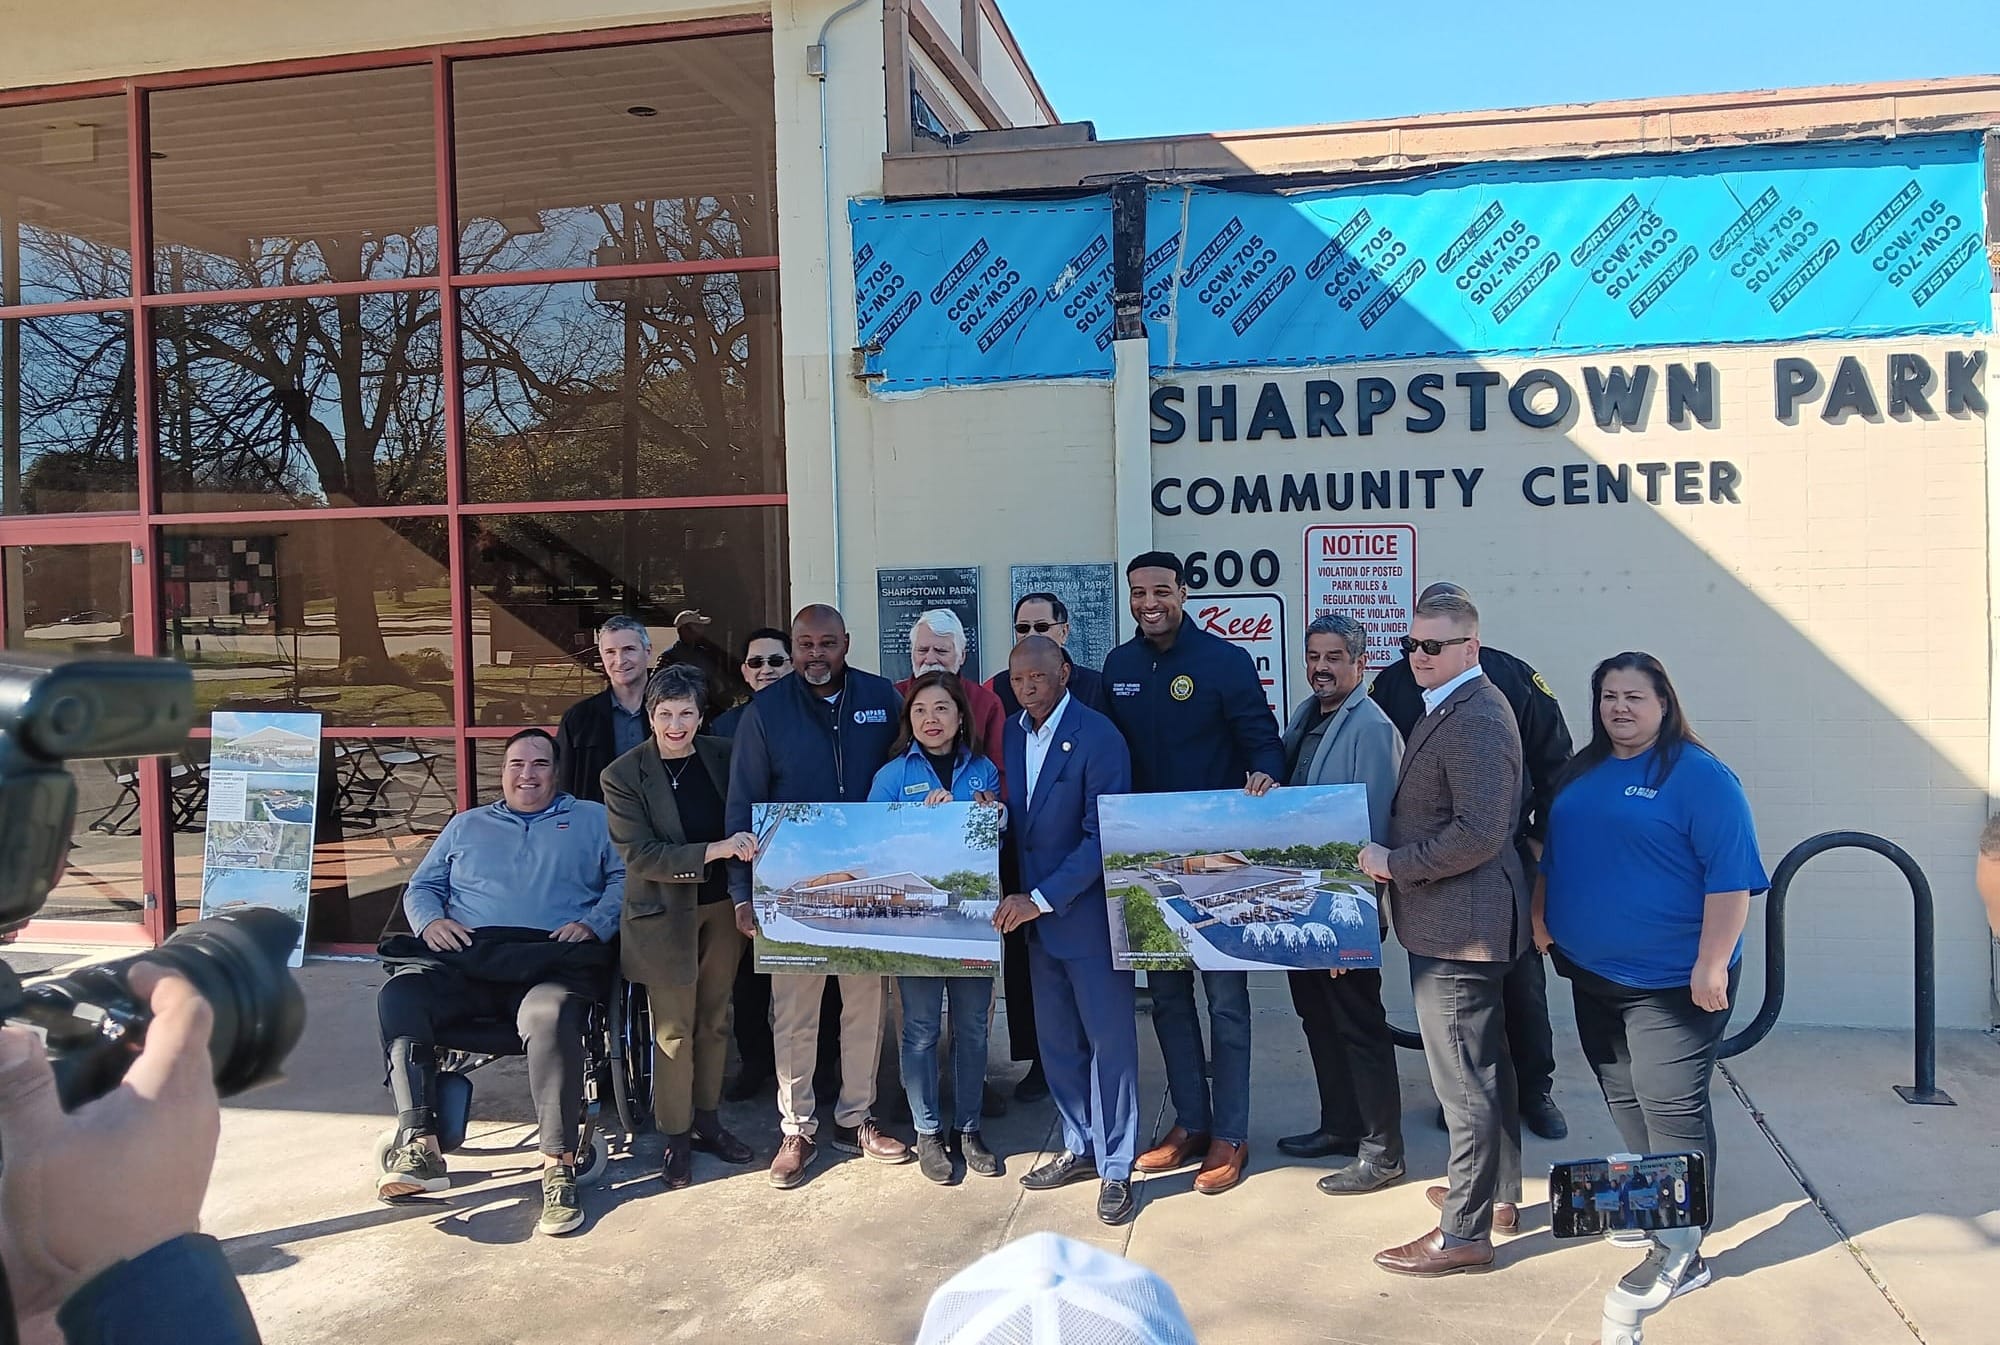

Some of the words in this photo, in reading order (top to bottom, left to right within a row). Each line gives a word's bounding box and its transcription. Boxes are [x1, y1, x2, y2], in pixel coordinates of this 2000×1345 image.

[1305, 208, 1372, 280] CARLISLE
[1436, 200, 1504, 273] CARLISLE
[1571, 194, 1640, 267] CARLISLE
[1592, 214, 1663, 284] CCW-705
[1709, 186, 1780, 260] CARLISLE
[1731, 207, 1803, 278] CCW-705
[1851, 179, 1922, 254] CARLISLE
[1873, 200, 1945, 272] CCW-705
[931, 238, 989, 305] CARLISLE
[1180, 216, 1244, 288] CARLISLE
[1199, 235, 1264, 304] CCW-705
[1325, 227, 1392, 297] CCW-705
[1456, 220, 1525, 290] CCW-705
[1628, 246, 1699, 319] CARLISLE
[1769, 239, 1840, 313] CARLISLE
[1913, 233, 1983, 308] CARLISLE
[948, 257, 1008, 321] CCW-705
[977, 287, 1037, 353] CARLISLE
[1232, 266, 1296, 336] CARLISLE
[1360, 259, 1426, 331] CARLISLE
[1492, 252, 1560, 324] CARLISLE
[1150, 362, 1714, 443] SHARPSTOWN
[1775, 351, 1987, 420] PARK
[1152, 468, 1484, 515] COMMUNITY
[1522, 460, 1739, 507] CENTER
[1318, 567, 1358, 577] VIOLATION
[1360, 567, 1370, 576] OF
[1373, 566, 1402, 576] POSTED
[1322, 535, 1398, 555] NOTICE
[881, 587, 945, 597] SHARPSTOWN
[949, 586, 972, 595] PARK
[1323, 594, 1376, 605] REGULATIONS
[1378, 594, 1397, 605] WILL
[1332, 581, 1352, 591] PARK
[1355, 581, 1379, 591] RULES
[1382, 581, 1388, 590] &
[1351, 608, 1365, 618] THE
[1367, 608, 1406, 618] VIOLATOR
[1199, 606, 1273, 642] Keep
[1366, 650, 1393, 661] ANCES.
[1367, 636, 1381, 647] BLE
[1381, 622, 1408, 633] UNDER
